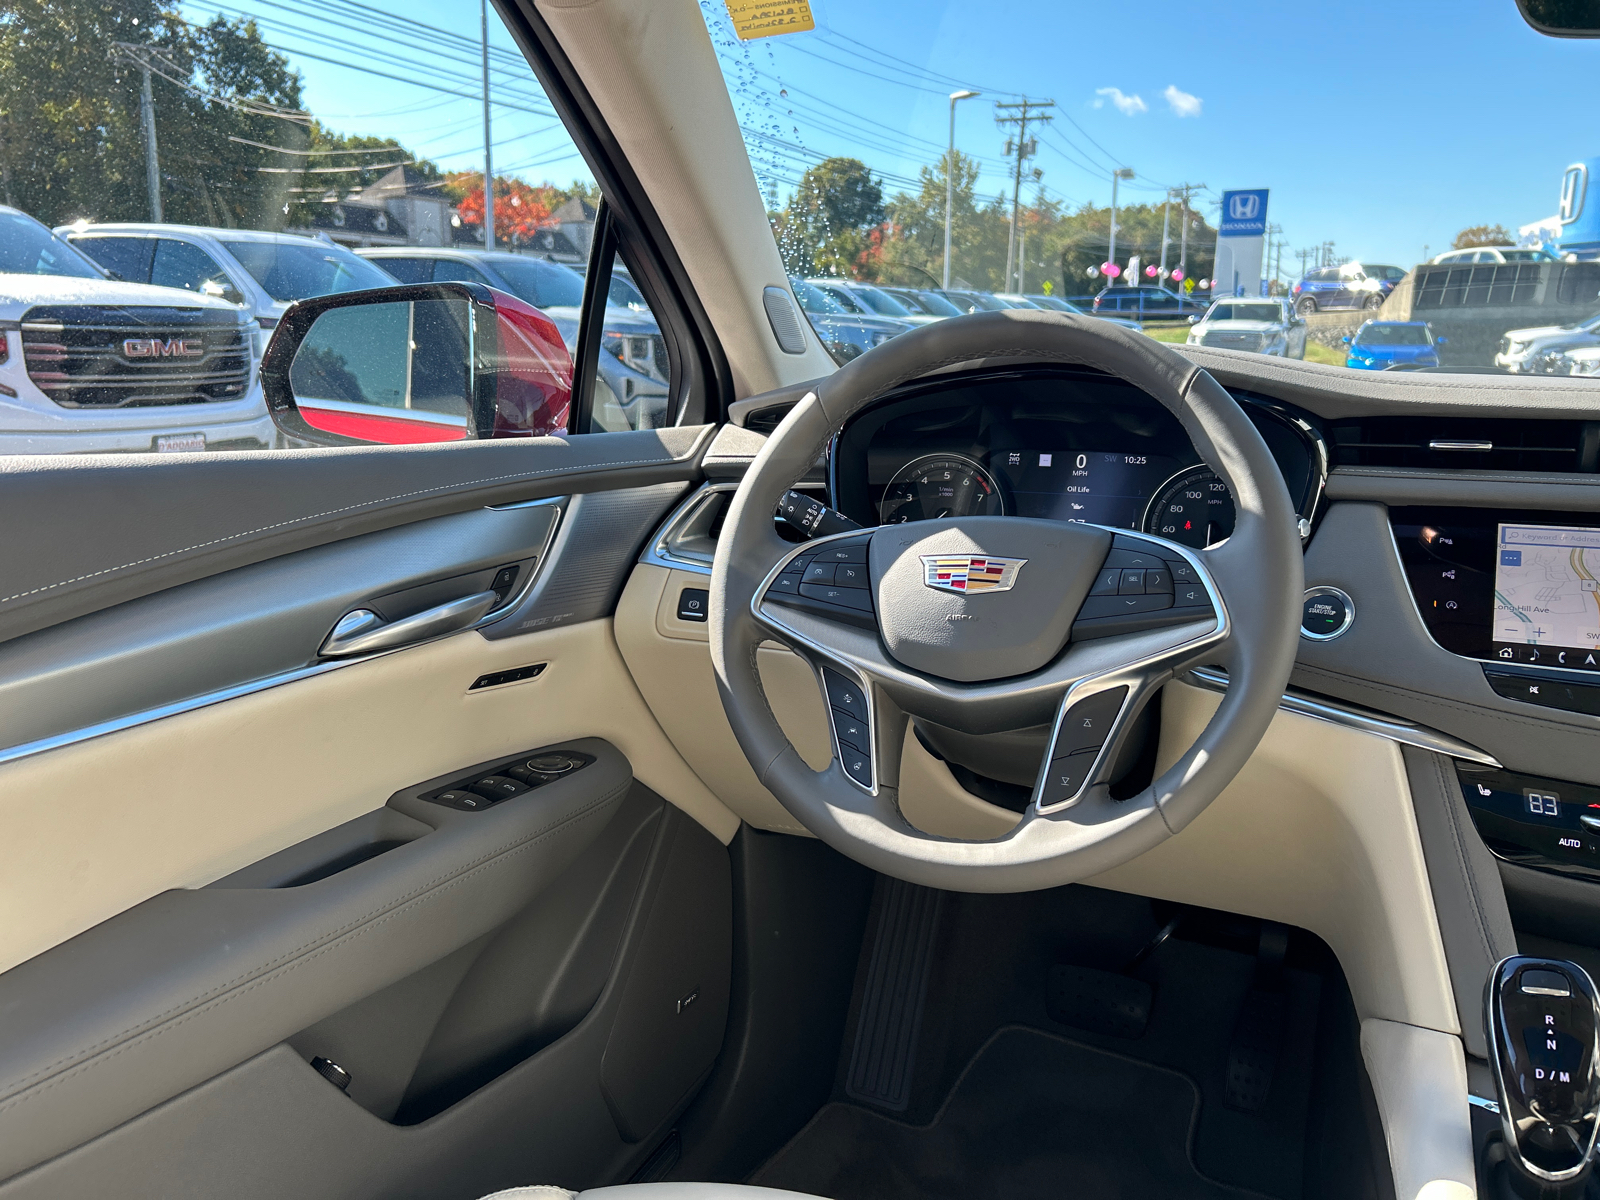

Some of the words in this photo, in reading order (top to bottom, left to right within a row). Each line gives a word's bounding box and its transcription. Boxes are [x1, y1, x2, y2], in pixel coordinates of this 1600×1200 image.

[123, 338, 204, 357] GMC
[1076, 454, 1087, 468] 0
[1104, 455, 1117, 463] SW
[1124, 456, 1147, 464] 10:25
[921, 476, 928, 484] 4
[944, 471, 951, 480] 5
[963, 478, 970, 486] 6
[1208, 483, 1226, 492] 120
[906, 494, 913, 502] 3
[977, 494, 984, 502] 7
[1185, 491, 1202, 499] 100
[1170, 504, 1183, 513] 80
[901, 515, 908, 523] 2
[1162, 525, 1176, 533] 60
[1522, 533, 1557, 542] Keyword
[1528, 792, 1558, 816] 83
[1559, 838, 1581, 848] AUTO
[1545, 1015, 1554, 1025] R
[1546, 1039, 1557, 1050] N
